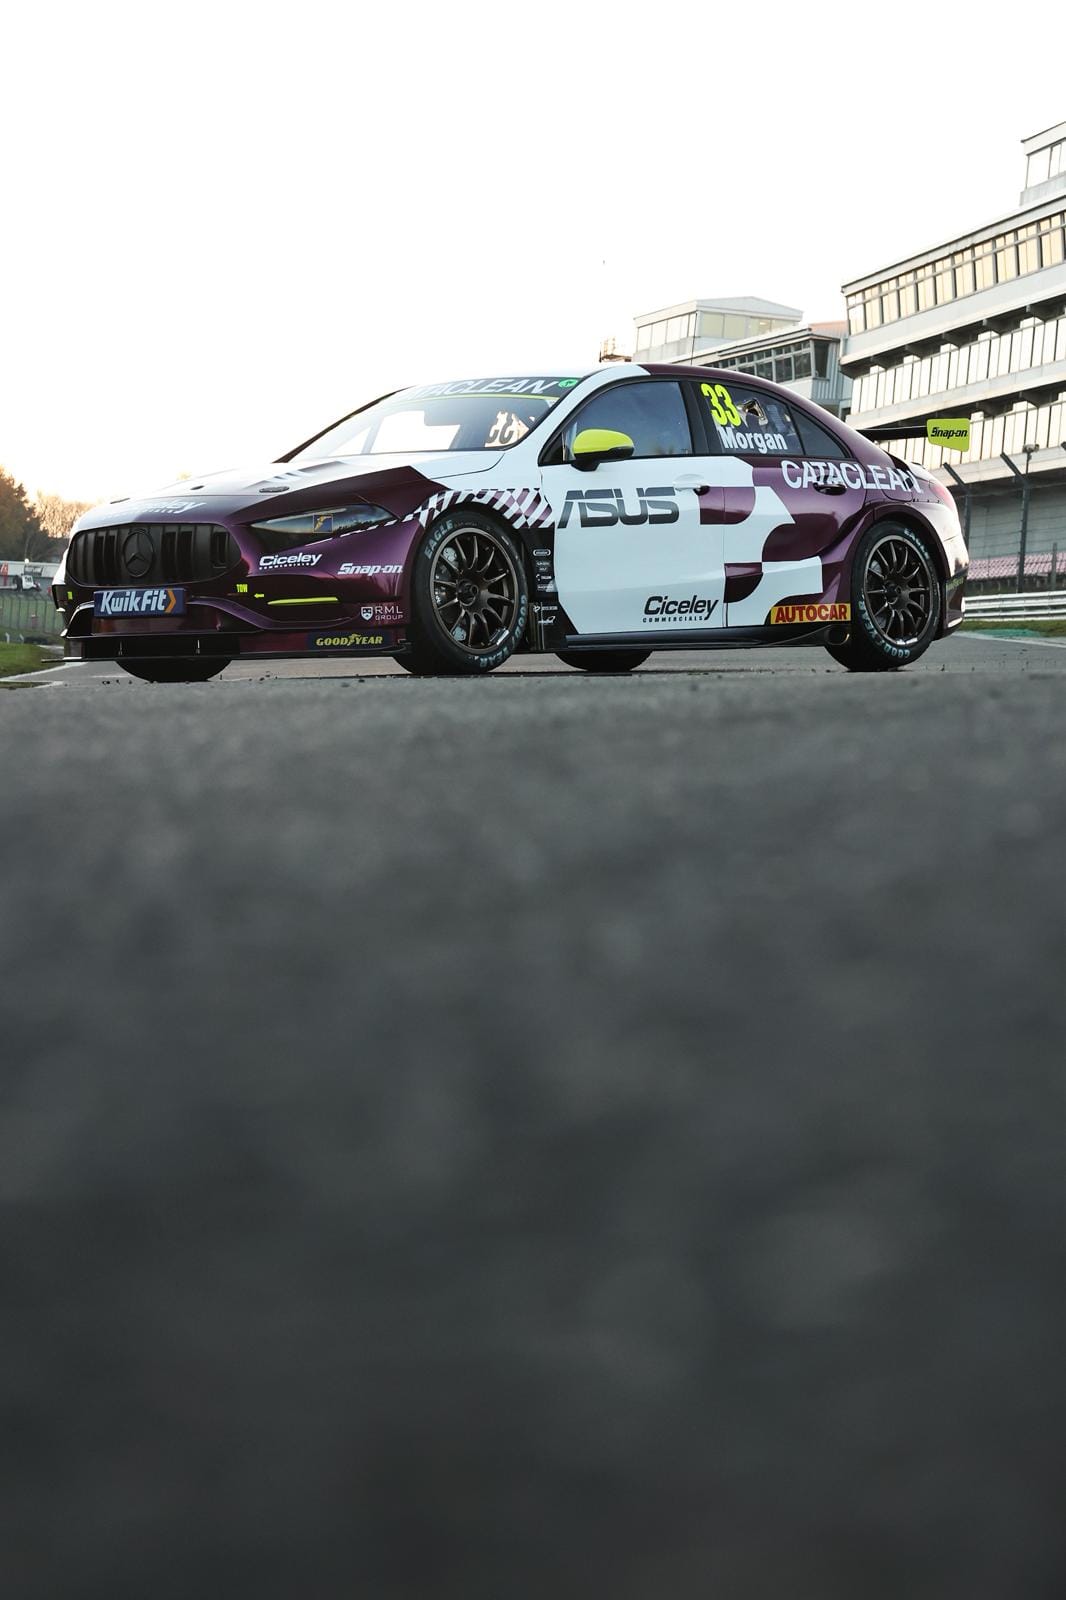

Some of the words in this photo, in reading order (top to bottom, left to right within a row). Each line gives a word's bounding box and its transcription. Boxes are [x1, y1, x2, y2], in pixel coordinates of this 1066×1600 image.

[701, 383, 742, 427] 33
[719, 425, 788, 454] Morgan
[930, 426, 968, 440] Snap-on
[781, 460, 921, 494] CATACLEAN
[557, 486, 680, 528] ASUS
[424, 519, 454, 560] EAGLE
[259, 552, 323, 566] Ciceley
[338, 562, 403, 577] Snap-on
[375, 605, 403, 614] RML
[642, 615, 703, 623] COMMERCIALS
[644, 595, 719, 621] Ciceley
[775, 604, 848, 623] AUTOCAR
